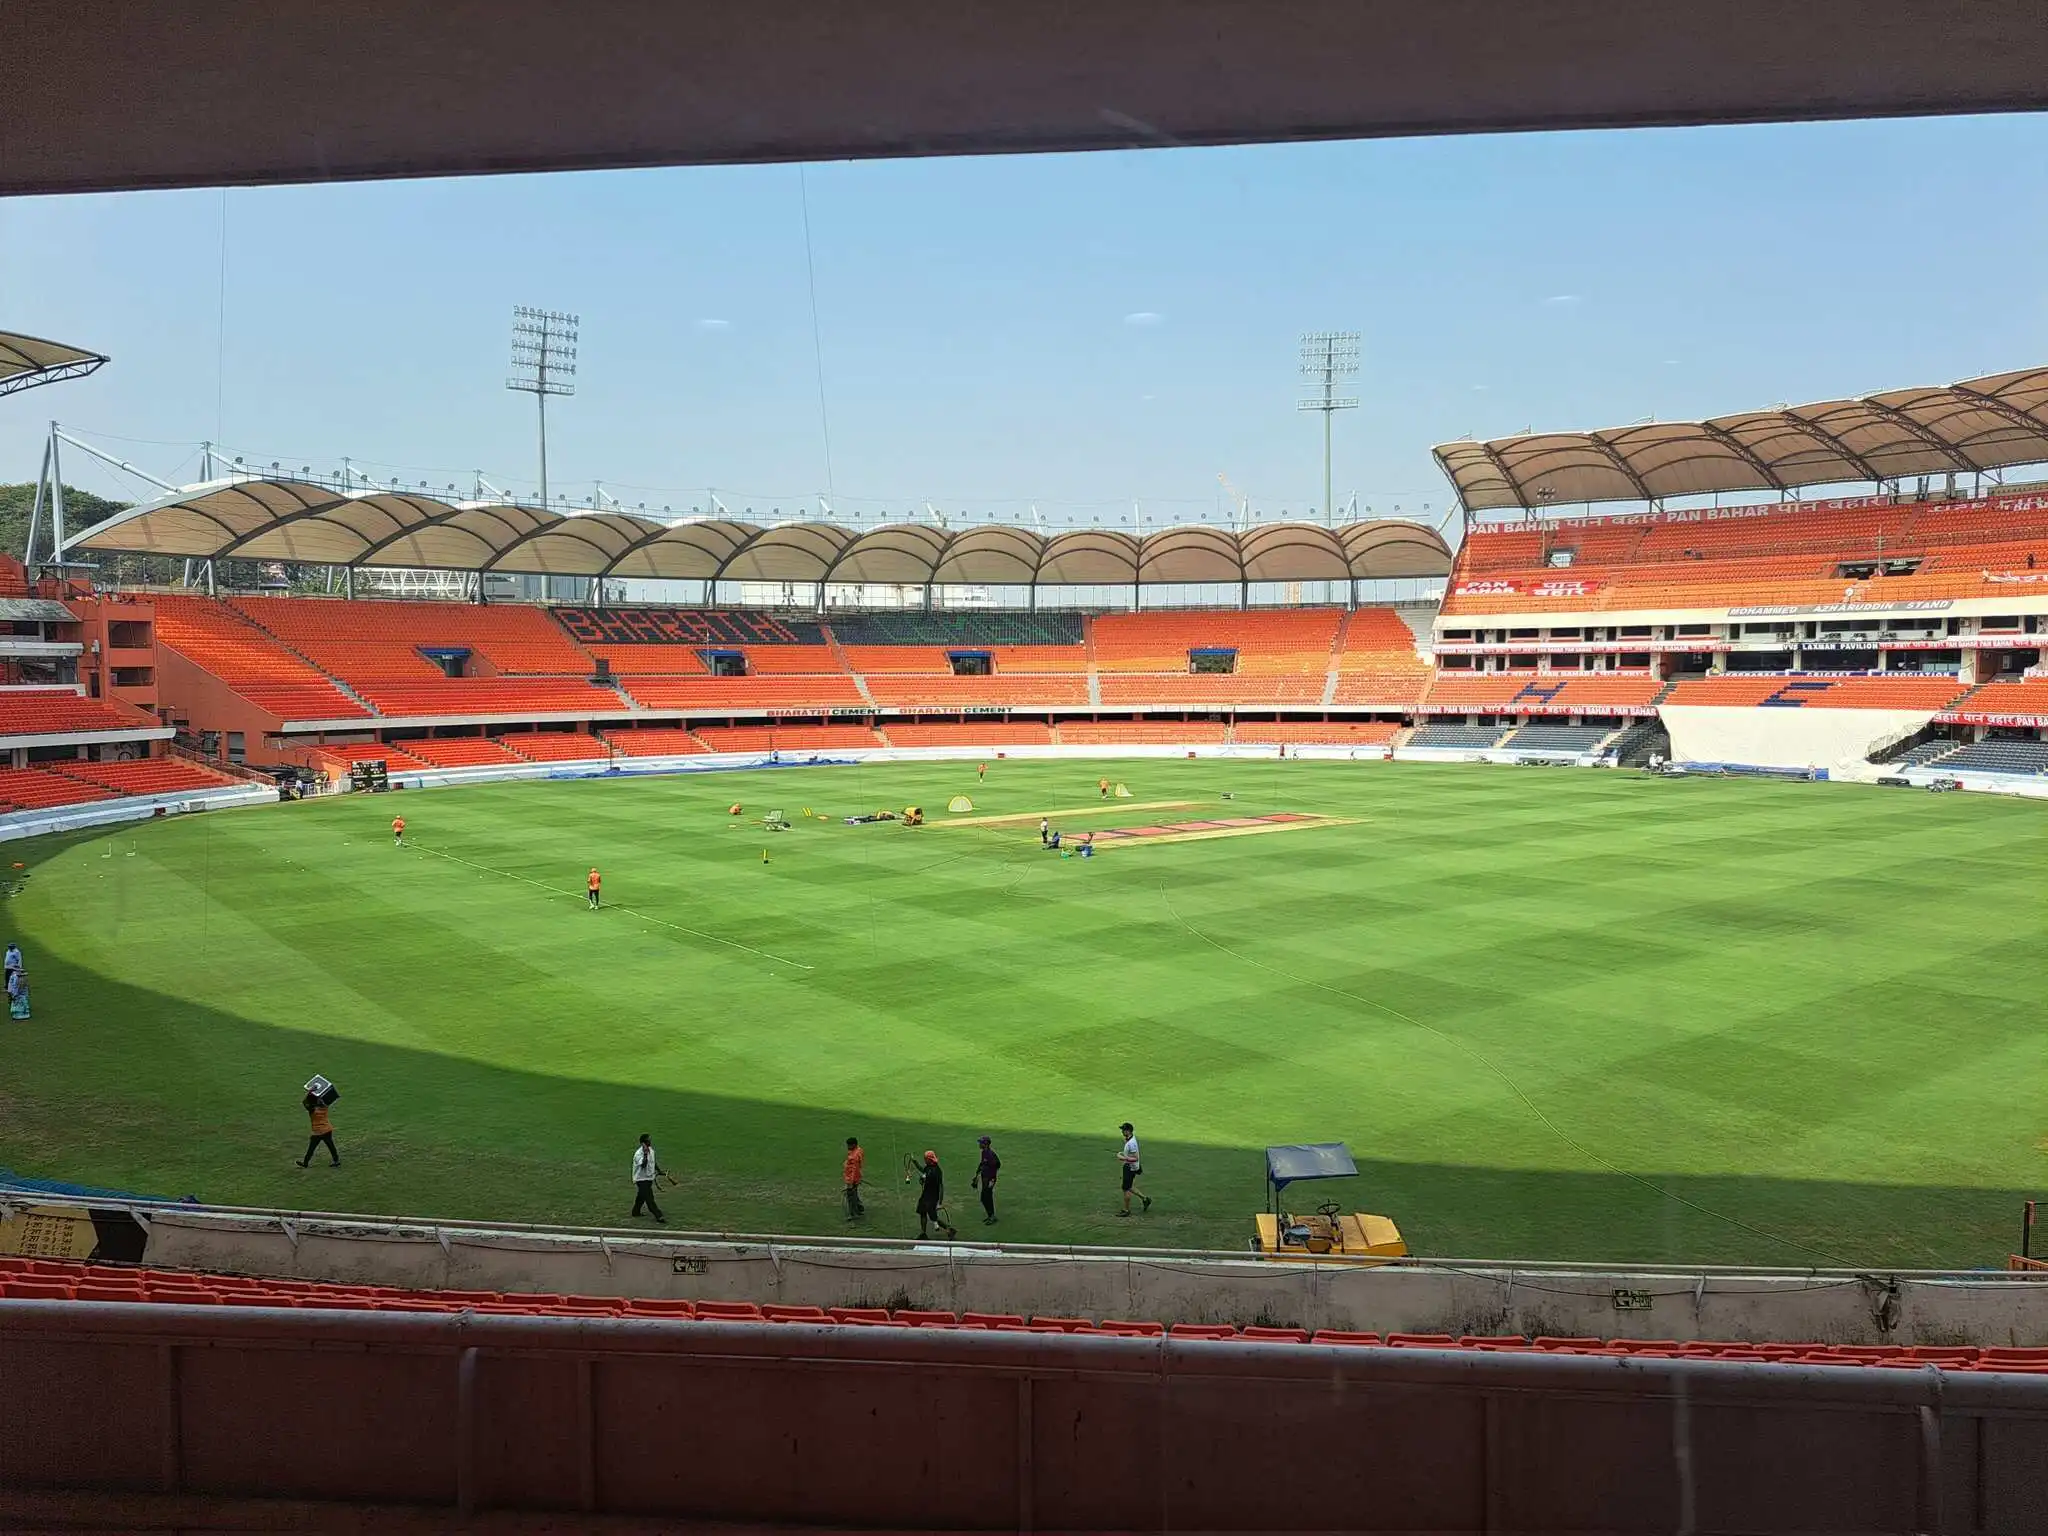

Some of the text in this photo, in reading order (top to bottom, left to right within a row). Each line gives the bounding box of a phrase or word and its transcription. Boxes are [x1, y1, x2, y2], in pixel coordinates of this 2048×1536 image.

[1468, 523, 1499, 535] PAN
[1504, 520, 1560, 534] BAHAR
[1565, 518, 1605, 528] पान
[1667, 510, 1700, 523] PAN
[1707, 505, 1769, 520] BAHAR
[1776, 501, 1818, 513] पान
[1455, 587, 1515, 595] BAHAR
[1729, 601, 1950, 616] MOHAMMED AZHARUDDIN STAND
[553, 610, 799, 640] BHARATHI
[1511, 682, 1568, 703] H
[766, 709, 830, 717] BHARATHI
